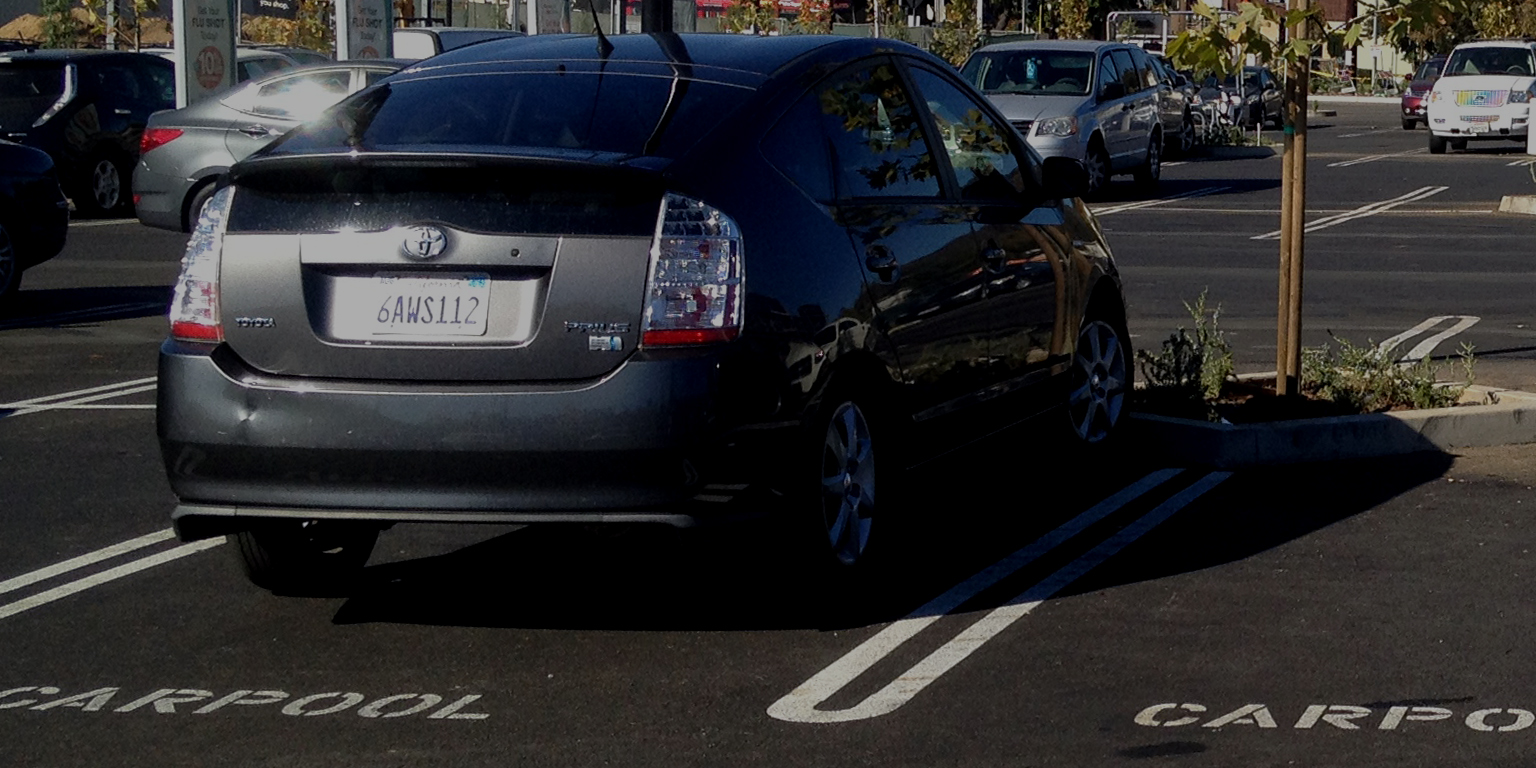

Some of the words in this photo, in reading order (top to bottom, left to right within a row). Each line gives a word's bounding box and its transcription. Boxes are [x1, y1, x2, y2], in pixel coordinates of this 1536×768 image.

[272, 1, 290, 10] shop.
[191, 18, 204, 28] FLU
[206, 18, 225, 28] SHOT
[352, 18, 365, 28] FLU
[365, 18, 383, 28] SHOT
[377, 295, 480, 324] 6AWS112
[235, 316, 277, 328] TOYOTA
[564, 320, 632, 334] PRIUS
[0, 686, 490, 720] CARPOOL
